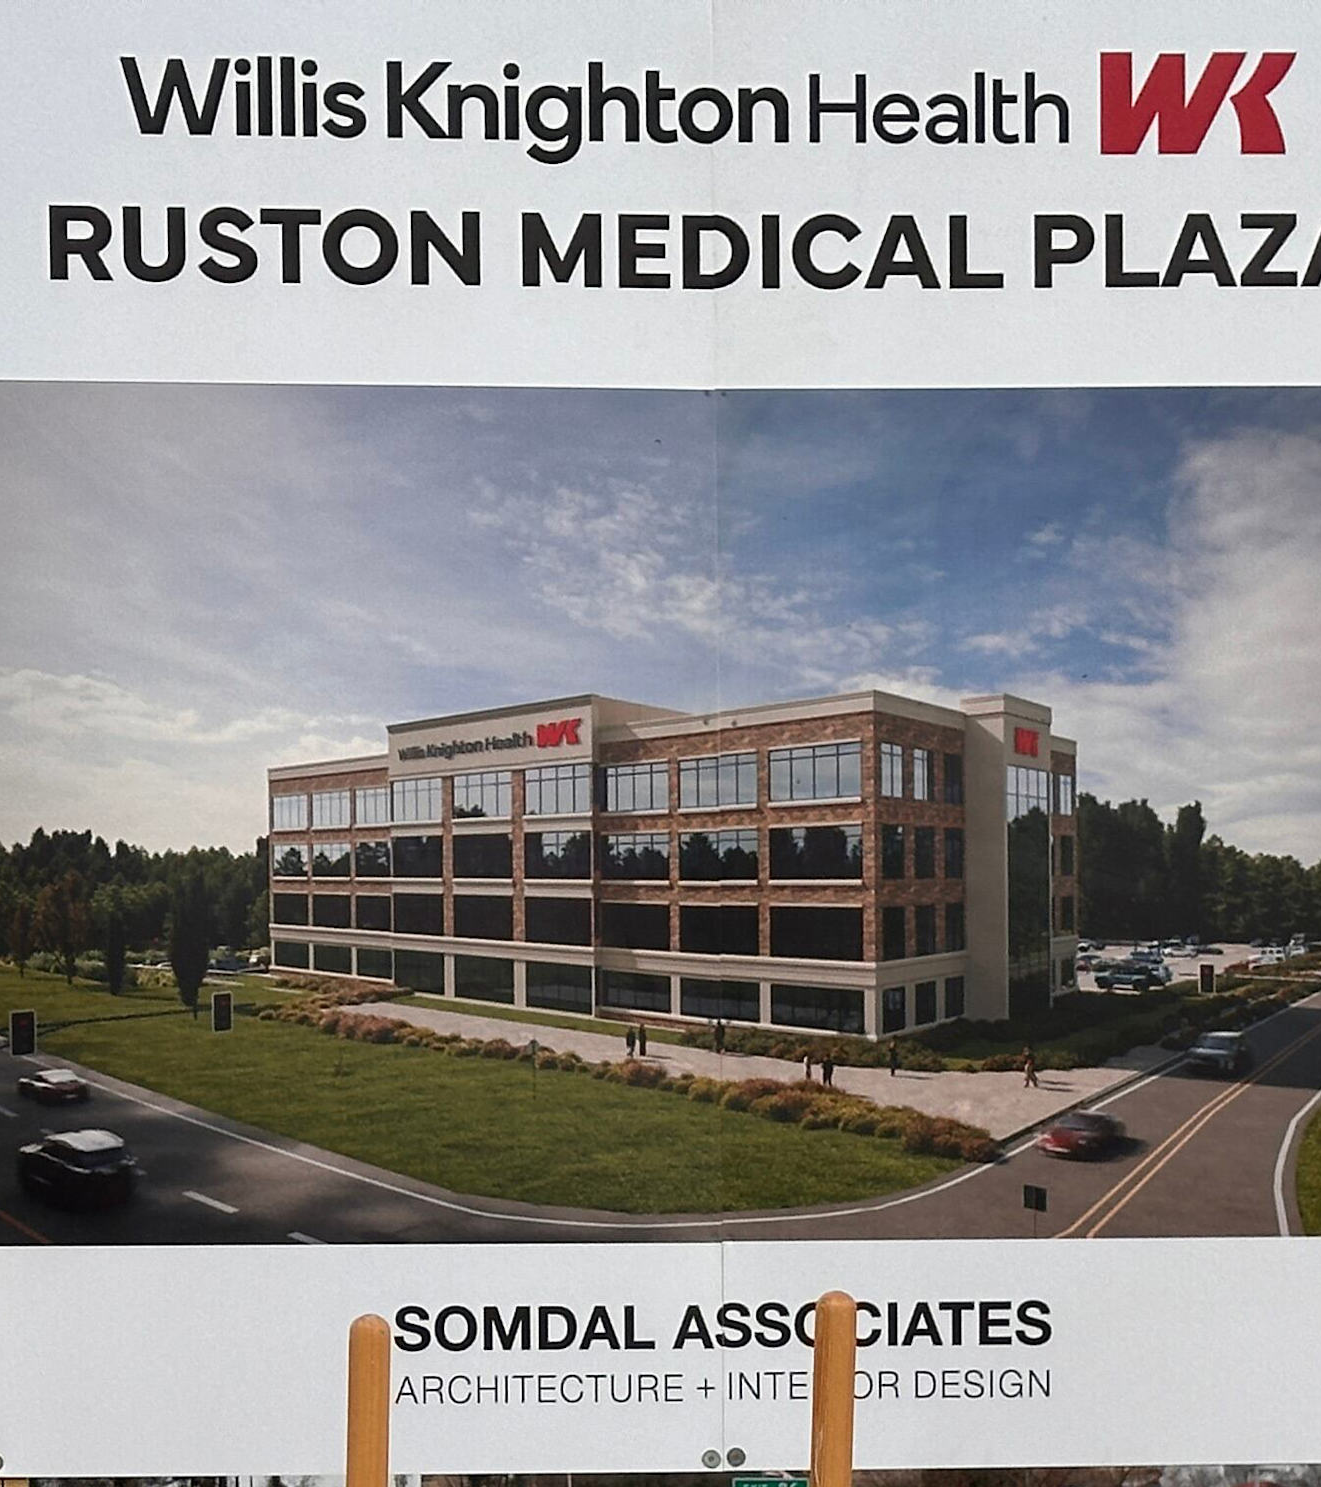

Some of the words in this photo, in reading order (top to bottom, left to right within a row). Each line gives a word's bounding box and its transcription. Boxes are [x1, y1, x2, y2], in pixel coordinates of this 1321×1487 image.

[120, 56, 366, 138] Willis
[387, 61, 789, 164] Knighton
[809, 72, 1069, 144] Health
[1100, 52, 1297, 154] WK
[48, 200, 481, 285] RUSTON
[521, 213, 1003, 289] MEDICAL
[426, 740, 483, 760] Knighton
[485, 730, 534, 752] Health
[393, 1305, 655, 1351] SOMDAL
[673, 1301, 1051, 1349] ASSOCIATES
[395, 1374, 684, 1404] ARCHITECTURE
[696, 1378, 716, 1399] +
[728, 1370, 900, 1401] INTEOR
[914, 1369, 1051, 1399] DESIGN
